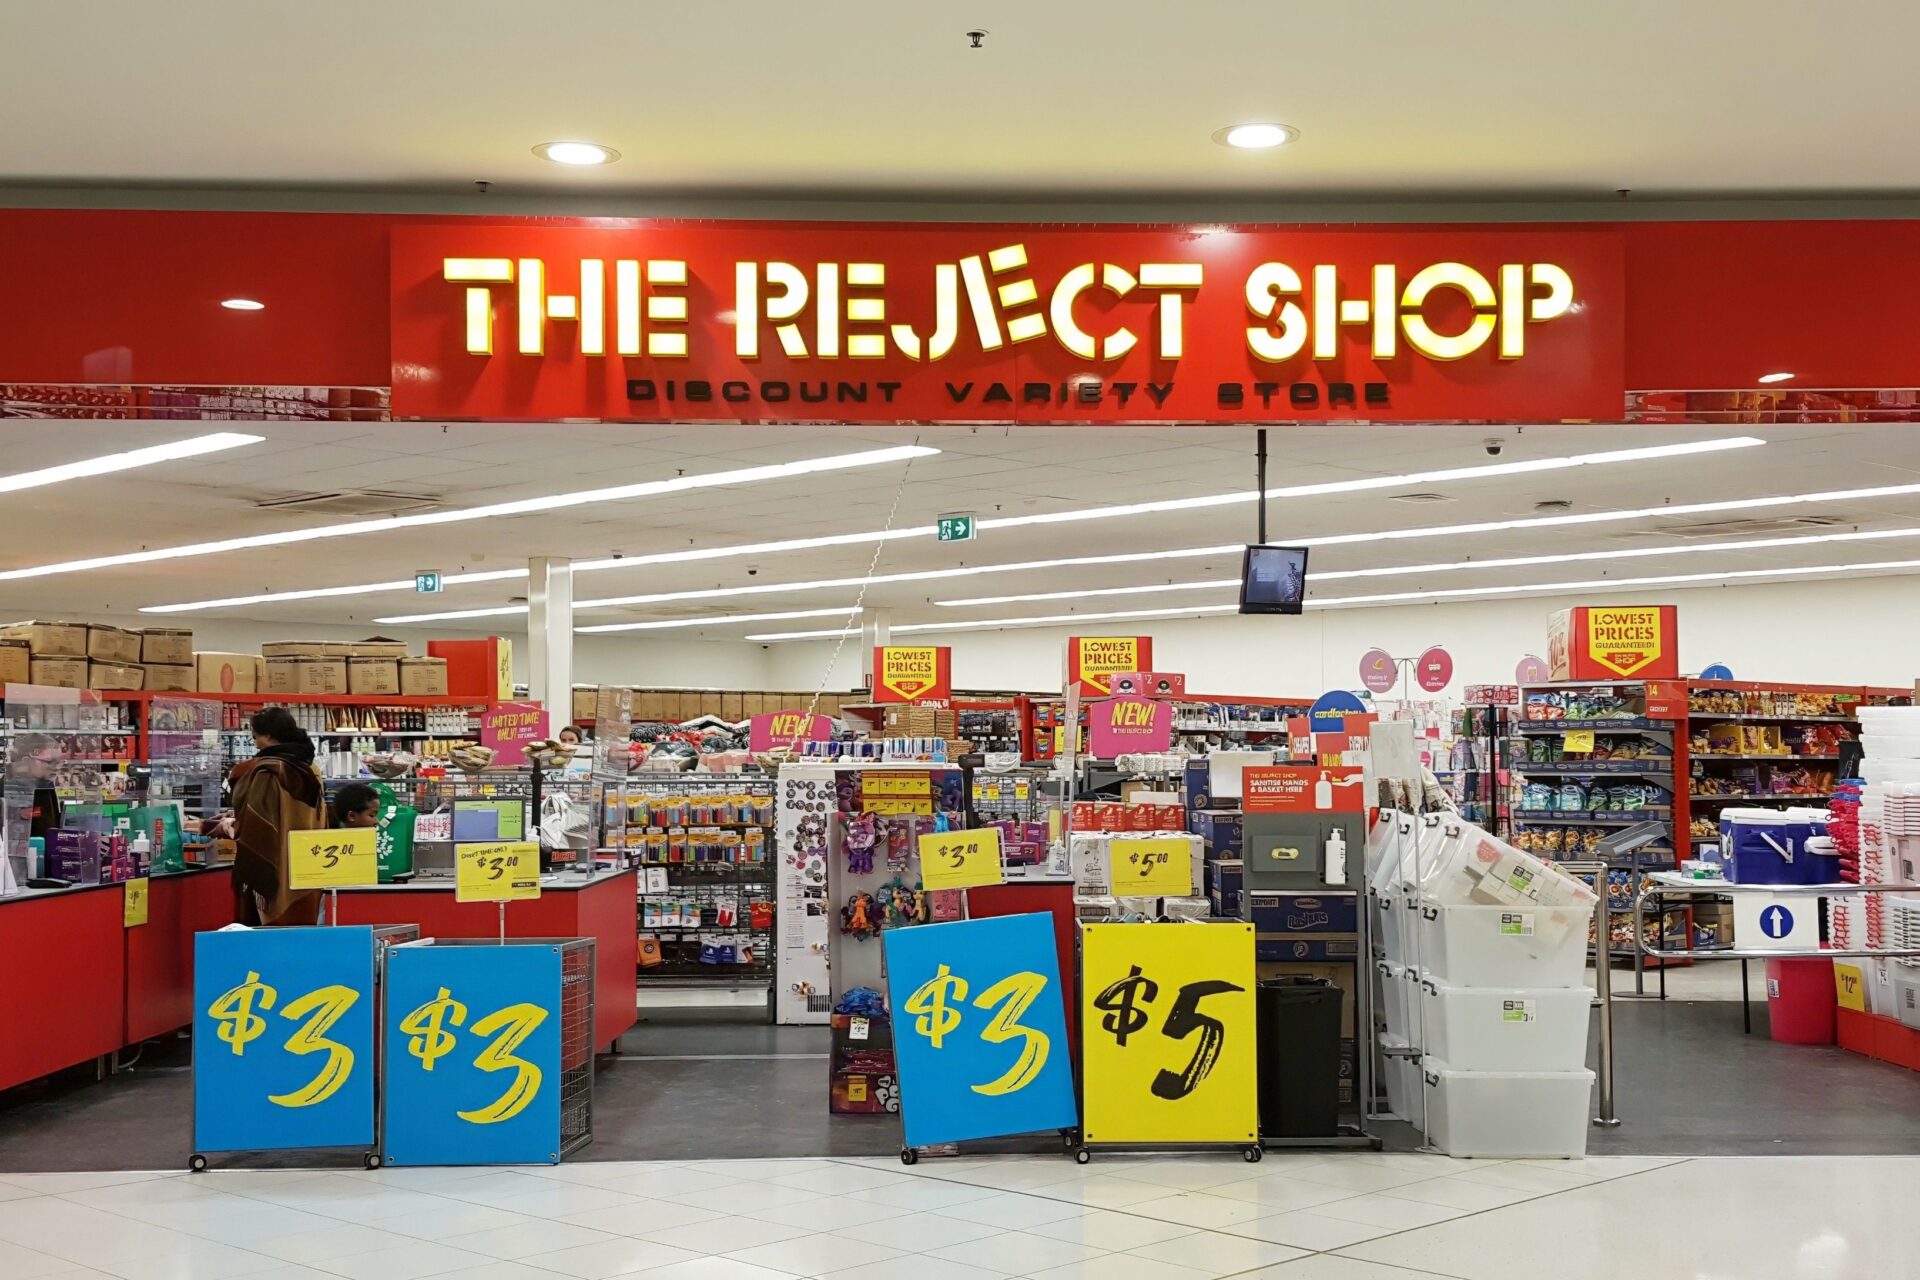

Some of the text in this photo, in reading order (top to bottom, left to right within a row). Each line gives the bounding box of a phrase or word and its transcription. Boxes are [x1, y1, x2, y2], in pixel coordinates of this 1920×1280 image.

[444, 244, 1574, 362] THE REJECT SHOP
[627, 380, 1390, 405] DISCOUNT VARIETY STORE
[1594, 613, 1654, 625] LOWEST
[1594, 627, 1655, 641] PRICES
[1084, 642, 1132, 652] LOWEST
[1595, 641, 1655, 649] GUARANTEED!
[887, 651, 932, 660] LOWEST
[1084, 653, 1132, 665] PRICES
[887, 661, 932, 672] PRICES
[1648, 685, 1658, 697] 14
[487, 712, 540, 729] LIMITED TIME
[1111, 701, 1157, 727] NEW!
[769, 714, 815, 737] NEW!
[1250, 779, 1281, 787] SANITISE
[904, 963, 1051, 1097] $3
[1093, 964, 1246, 1101] $5
[208, 970, 361, 1108] $3
[399, 987, 550, 1124] $3
